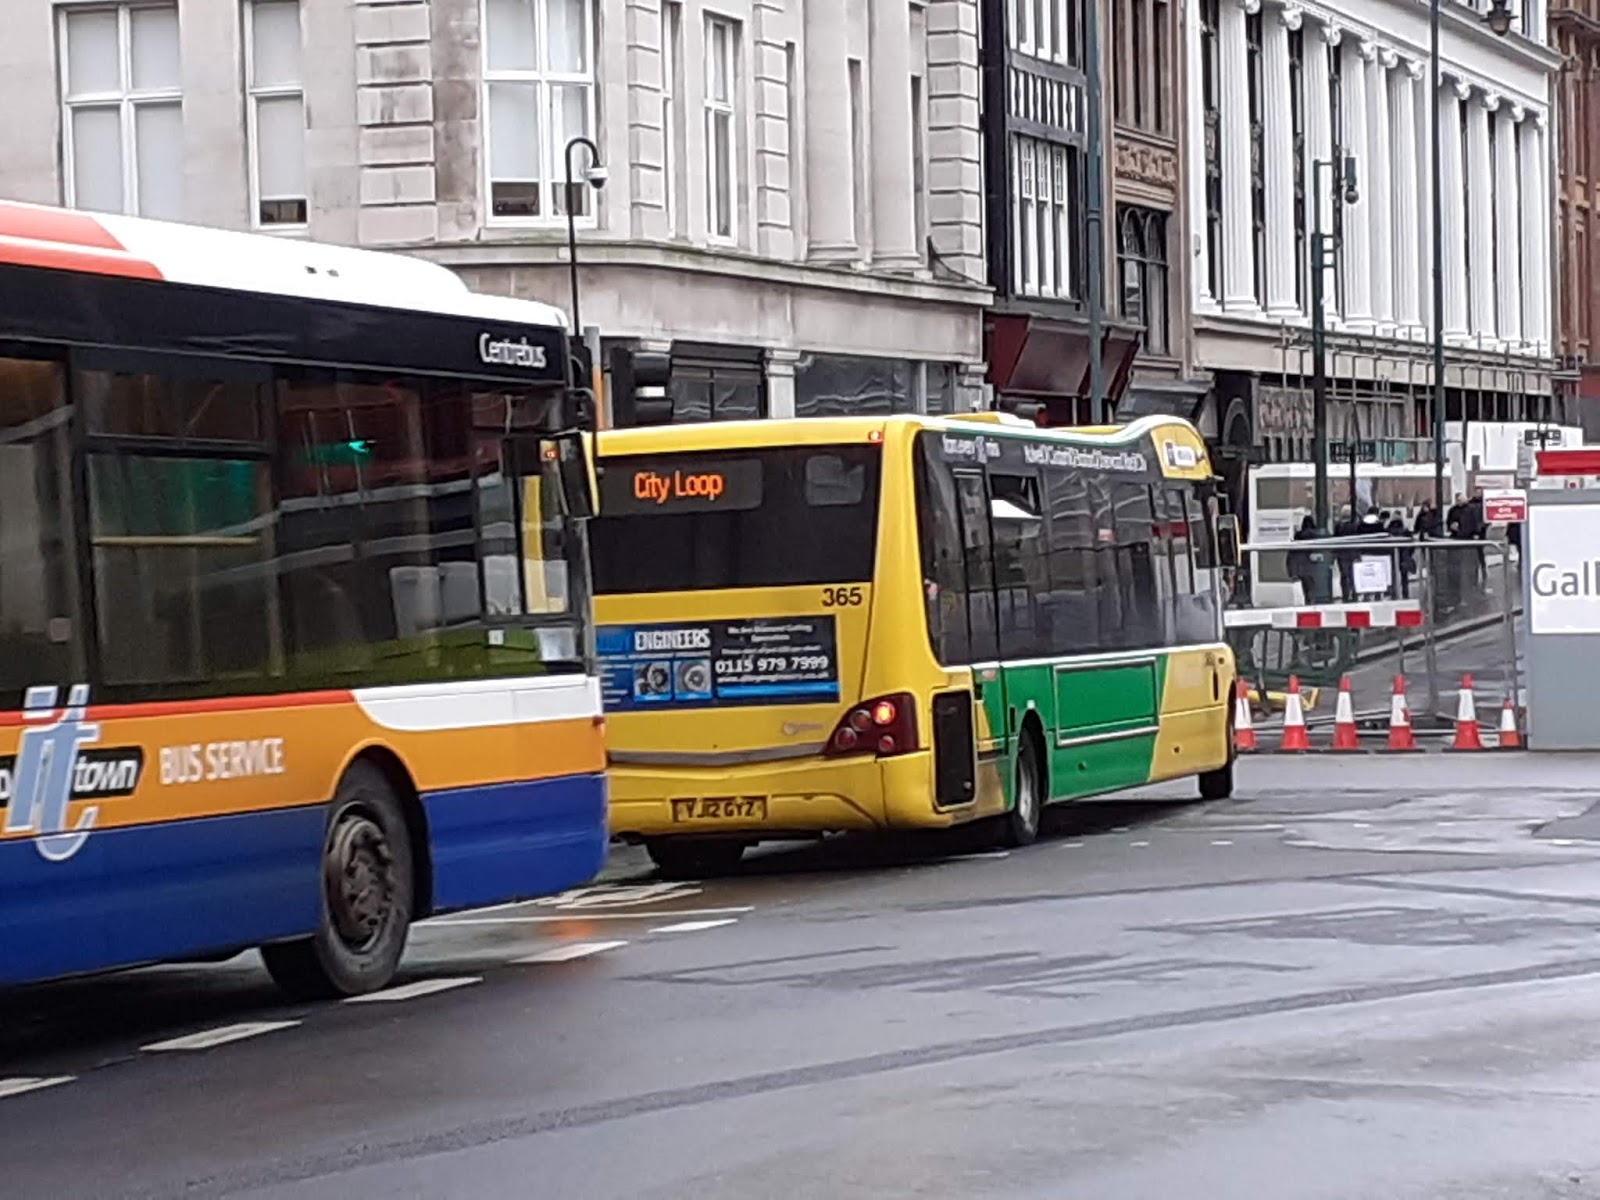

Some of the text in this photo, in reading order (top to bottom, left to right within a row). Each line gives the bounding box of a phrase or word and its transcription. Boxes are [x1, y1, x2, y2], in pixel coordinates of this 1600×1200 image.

[479, 332, 547, 368] Centrebus
[634, 470, 723, 504] City Loop
[822, 586, 862, 607] 365
[715, 655, 754, 674] 0115
[757, 657, 787, 672] 979
[72, 756, 139, 792] town
[160, 738, 285, 785] BUS SERVICE
